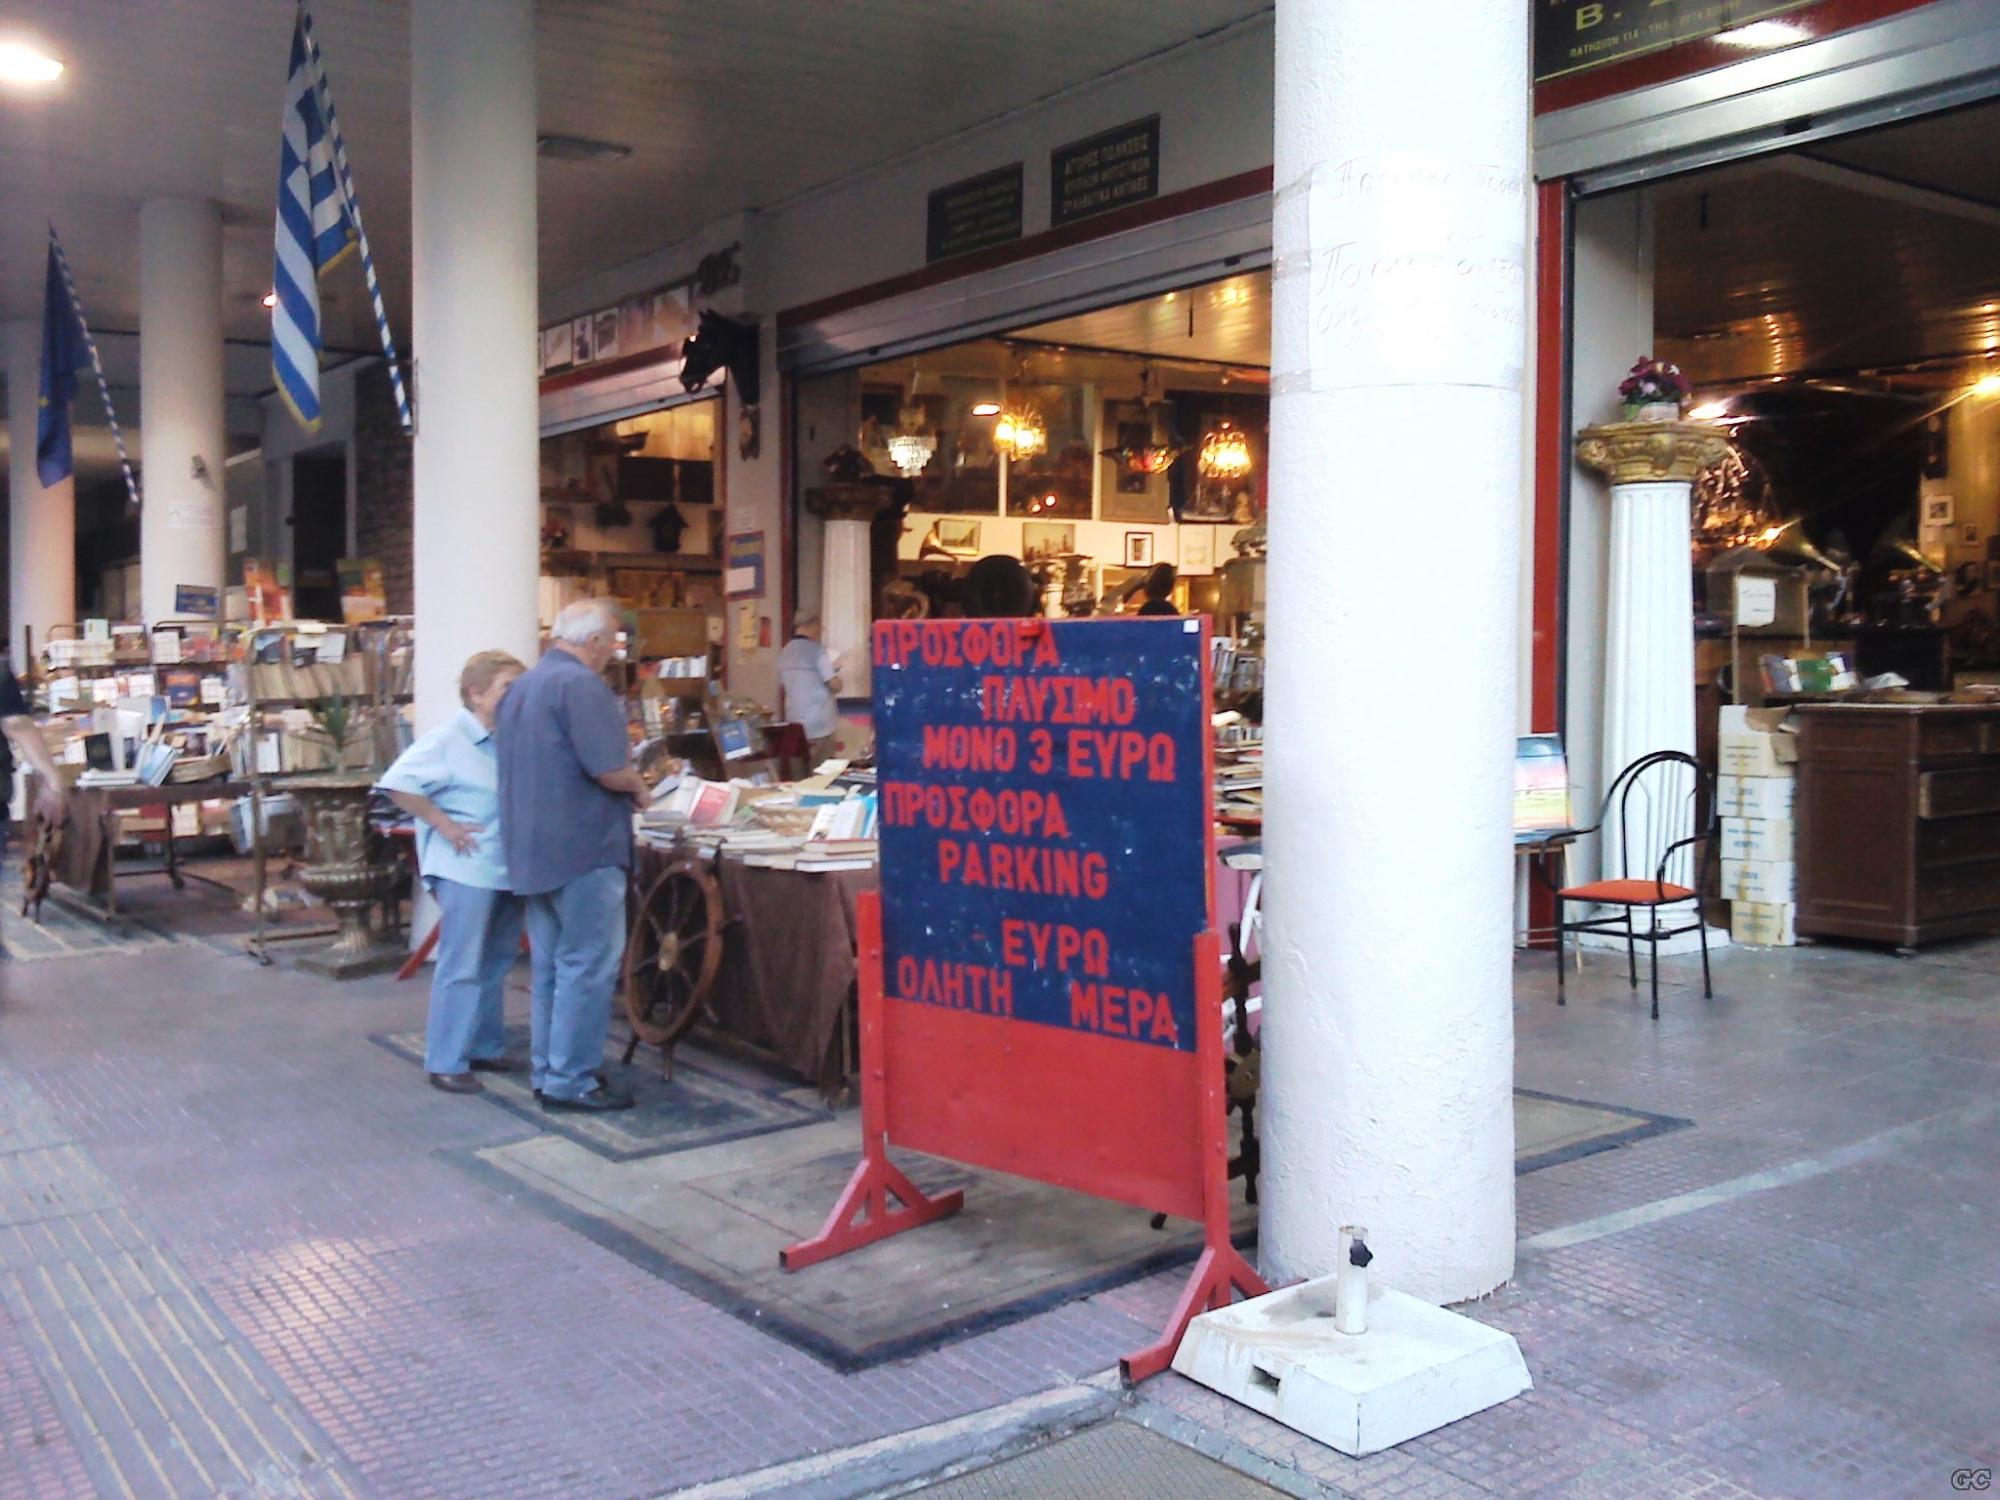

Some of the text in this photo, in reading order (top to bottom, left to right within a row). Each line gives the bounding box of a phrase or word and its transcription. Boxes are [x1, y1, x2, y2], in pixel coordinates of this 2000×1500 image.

[981, 675, 1137, 725] ΠΛΥΣΙΜΟ
[923, 725, 1176, 782] ΜΟΝΟ 3 ΕΥΡΩ
[883, 781, 1069, 839] ΠΡΟΣΦΟΡΑ
[938, 839, 1108, 899] PARKING
[1002, 918, 1110, 978] ΕΥΡΩ
[1069, 979, 1178, 1041] ΜΕΡΑ
